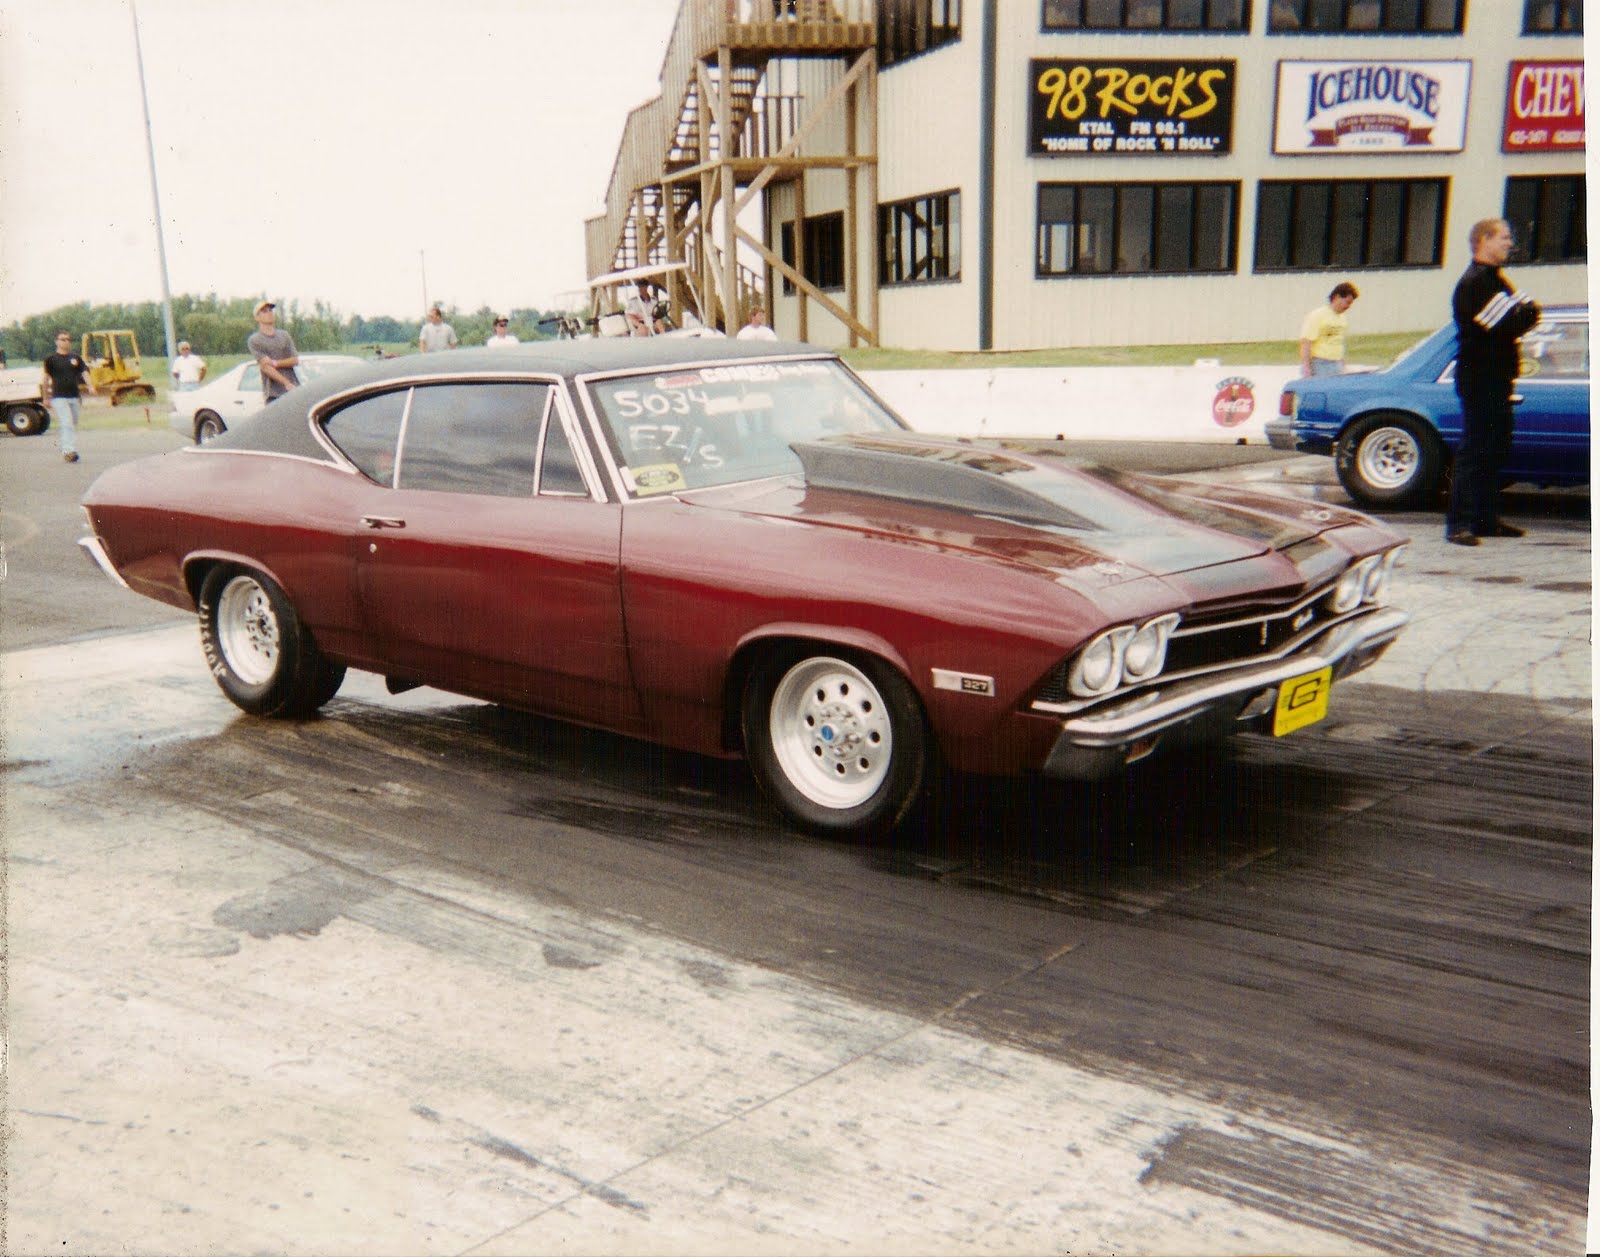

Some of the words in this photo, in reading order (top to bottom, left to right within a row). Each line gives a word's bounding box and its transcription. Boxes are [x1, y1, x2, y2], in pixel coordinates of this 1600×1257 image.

[1038, 66, 1092, 120] 98
[1095, 67, 1226, 119] ROCKS
[1306, 66, 1441, 122] ICEHOUSE
[1079, 122, 1114, 135] KTAL
[1130, 122, 1151, 135] FM
[1042, 137, 1089, 151] "HOME
[1093, 137, 1112, 151] OF
[1115, 137, 1156, 151] ROCK
[963, 679, 988, 691] 327
